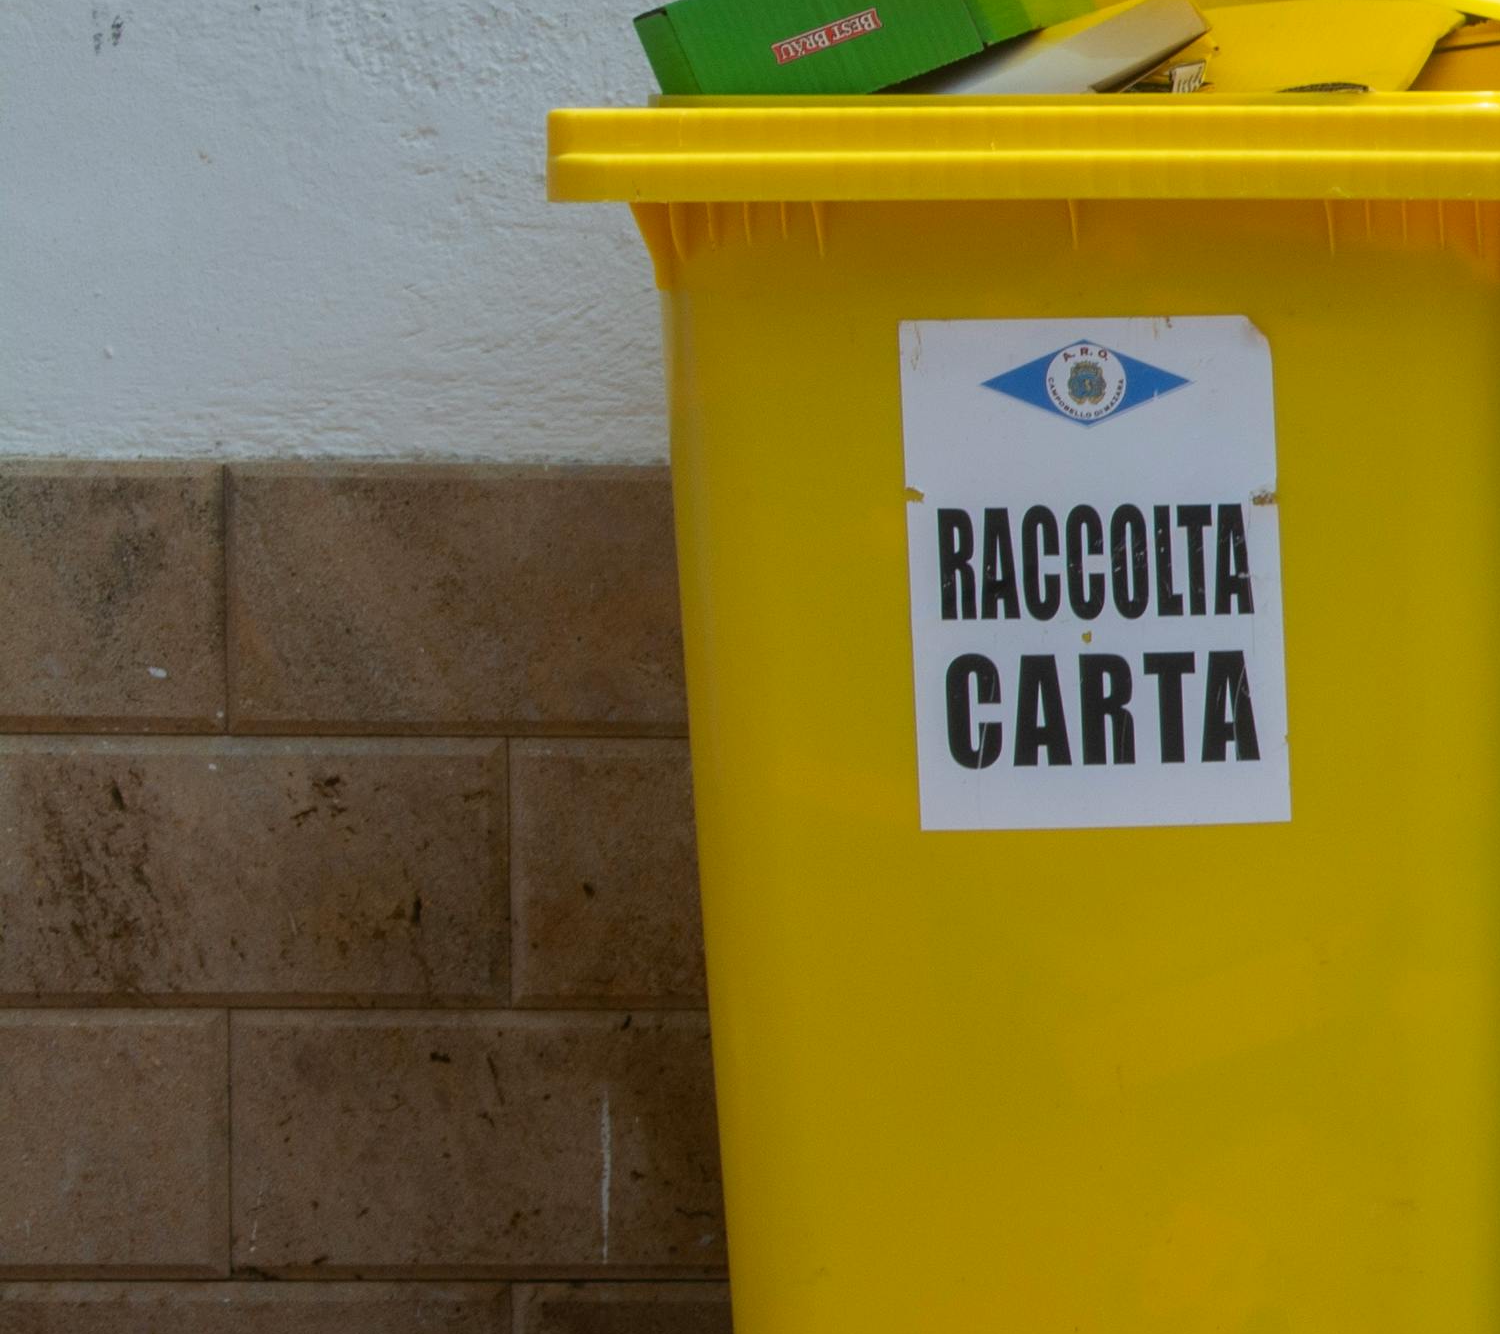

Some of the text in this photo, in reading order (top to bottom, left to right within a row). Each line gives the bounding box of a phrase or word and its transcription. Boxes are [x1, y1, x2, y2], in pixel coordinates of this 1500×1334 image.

[780, 13, 876, 60] BEST BRÄU
[1048, 377, 1092, 418] CAMPOBELLO
[1103, 378, 1124, 412] MAZARA
[937, 503, 1255, 621] RACCOLTA
[945, 650, 1261, 770] CARTA
